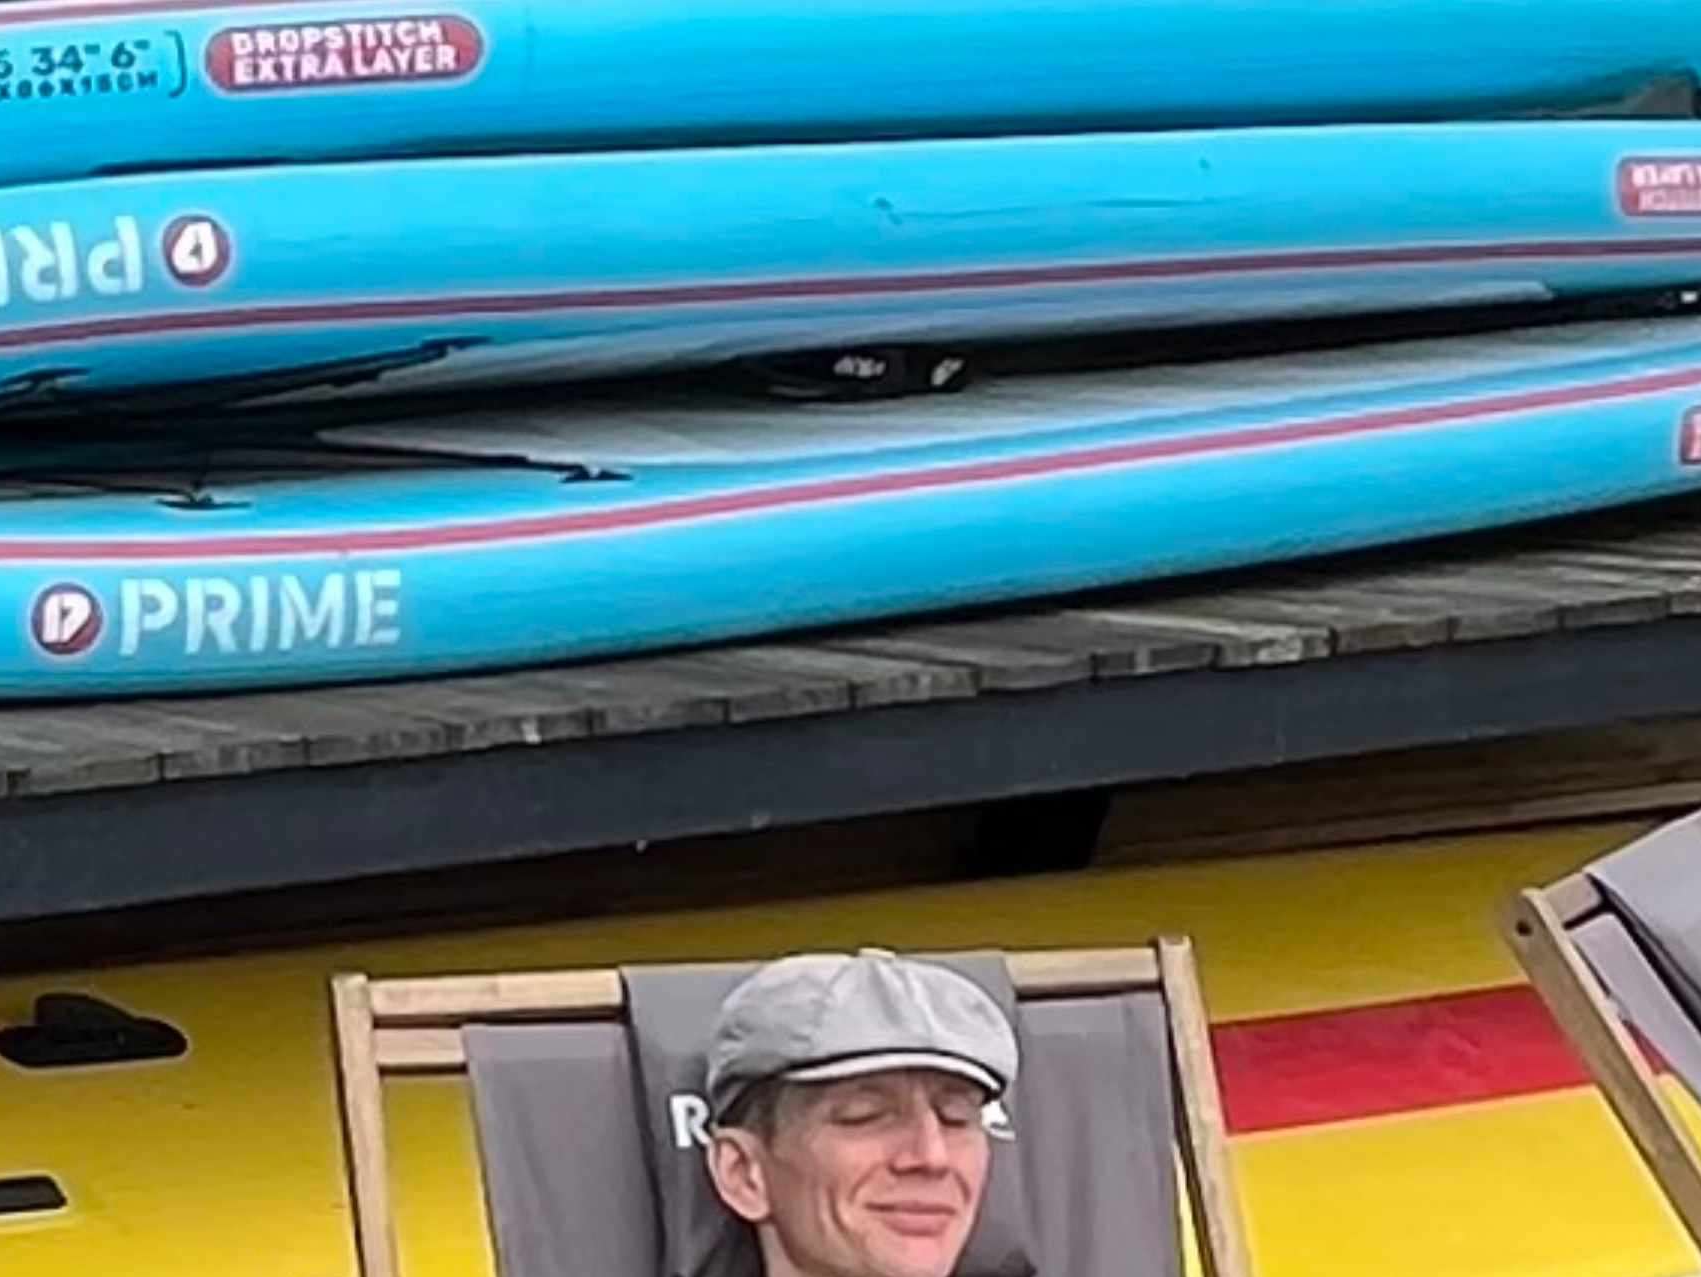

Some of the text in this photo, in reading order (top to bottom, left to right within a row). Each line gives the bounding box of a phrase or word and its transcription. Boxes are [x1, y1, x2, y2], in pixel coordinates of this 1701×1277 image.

[231, 20, 444, 56] DROPSTITCH
[233, 44, 459, 85] EXTRA LAYER
[118, 569, 403, 657] PRIME
